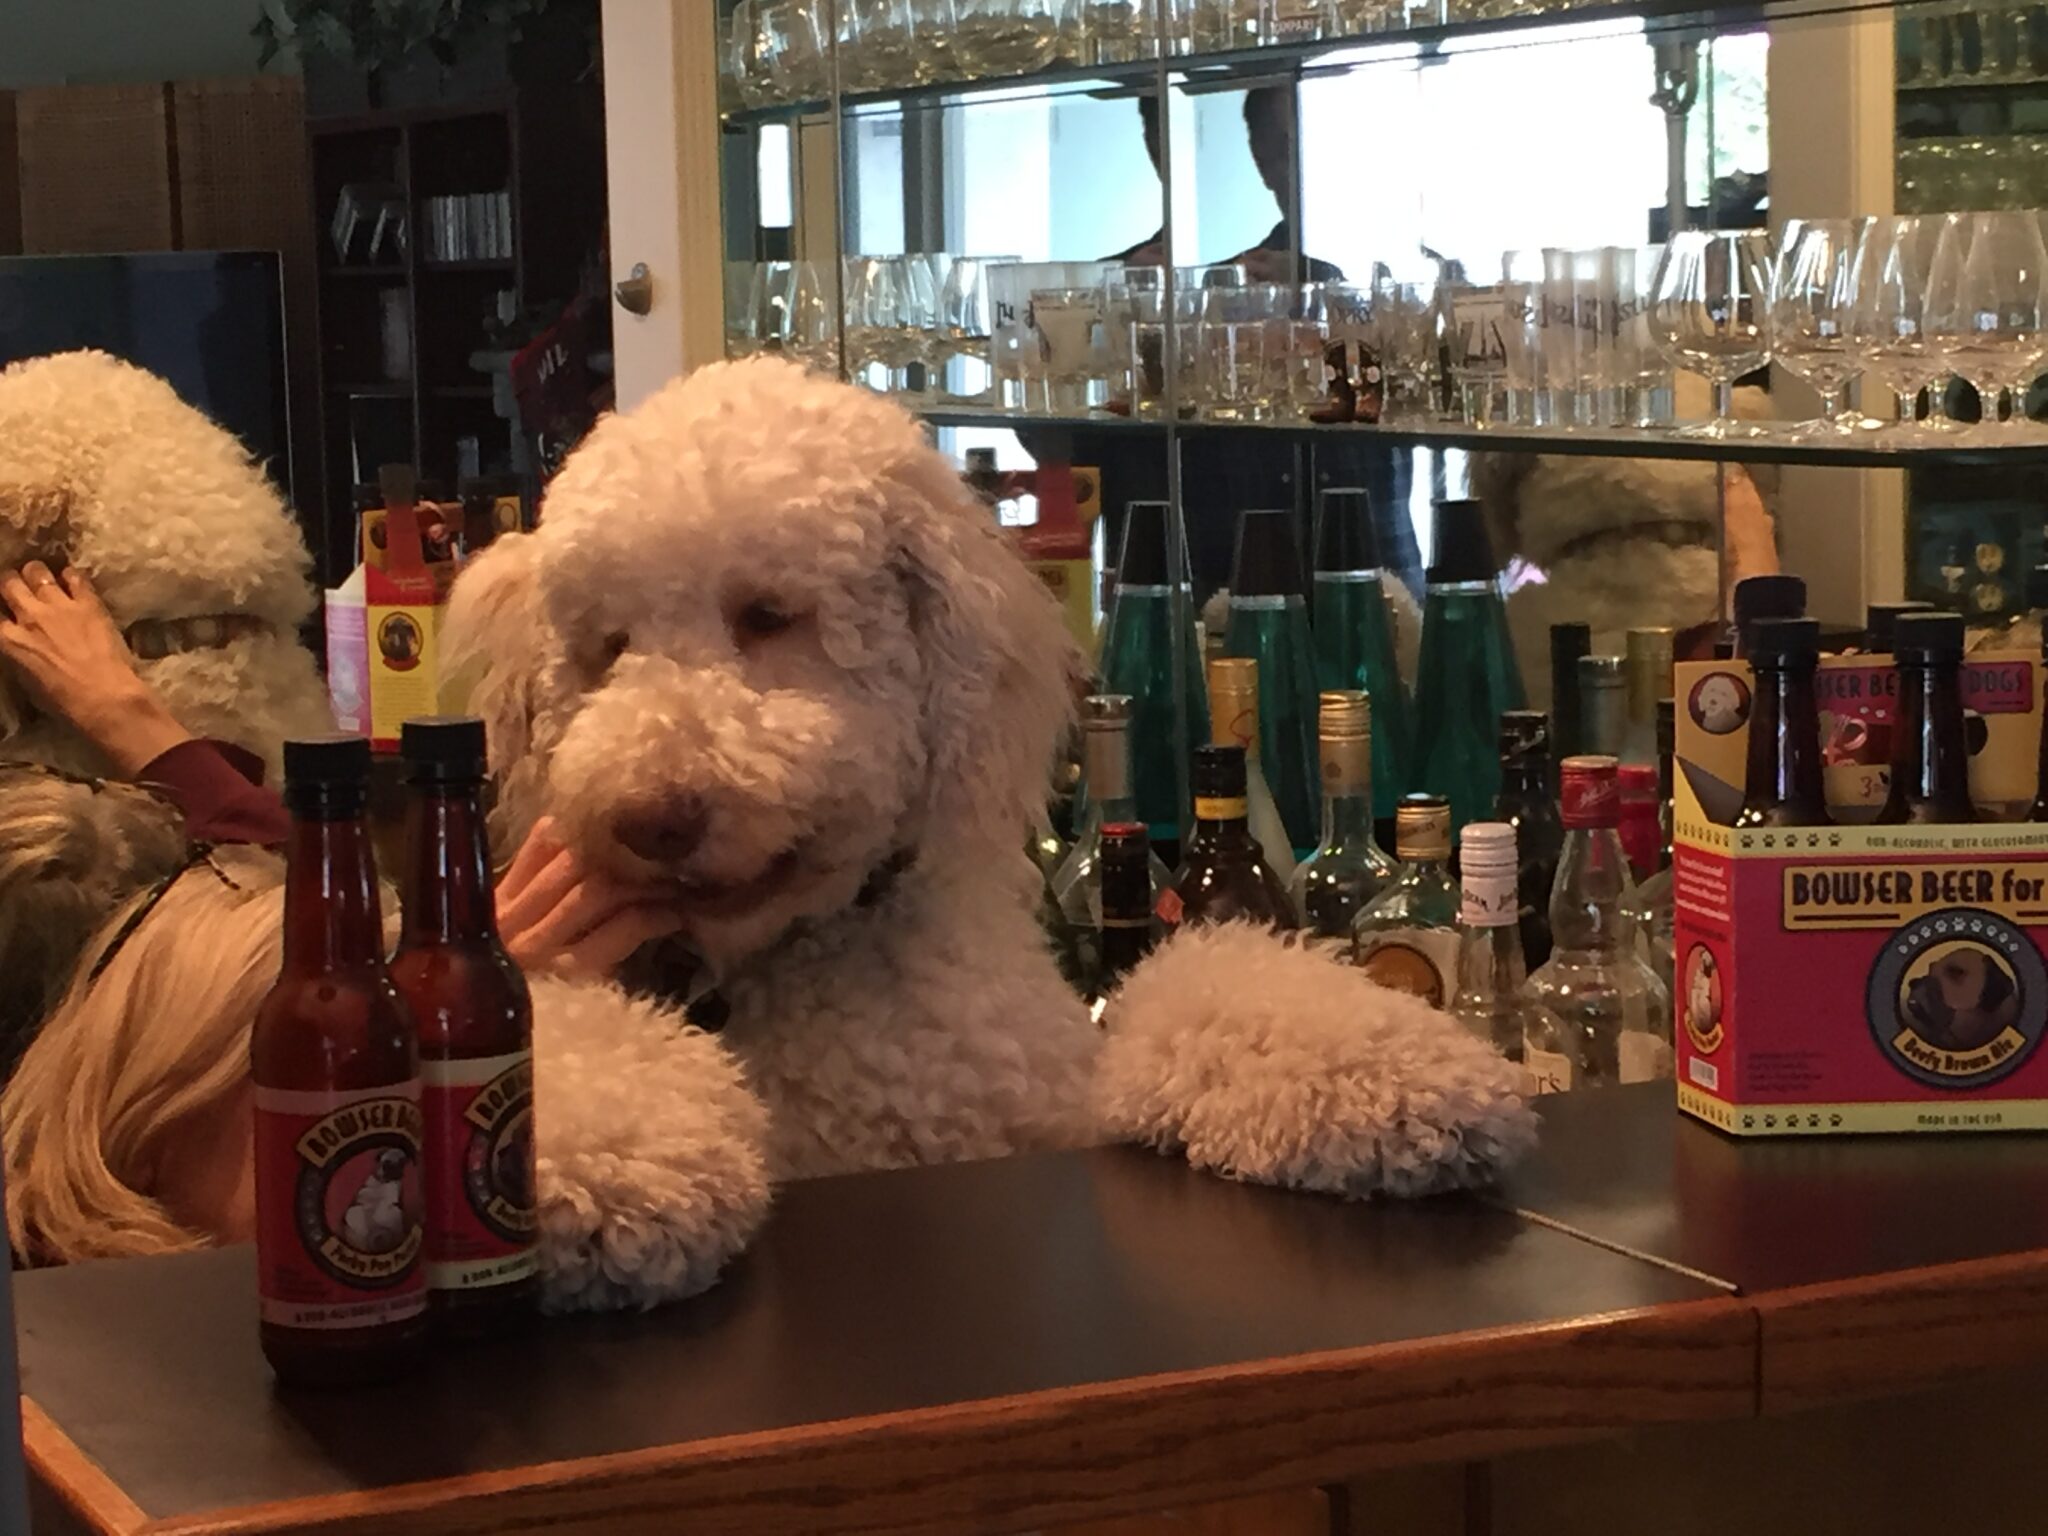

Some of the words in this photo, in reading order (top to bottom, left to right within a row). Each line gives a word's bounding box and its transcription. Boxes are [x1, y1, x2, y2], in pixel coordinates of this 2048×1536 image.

[1792, 869, 1913, 906] BOWSER
[1921, 869, 1994, 903] BEER
[2002, 868, 2045, 902] for
[1903, 1037, 1942, 1071] Beefy
[1944, 1054, 1991, 1071] Brown
[1991, 1037, 2015, 1060] Ale
[306, 1104, 394, 1158] BOWSER
